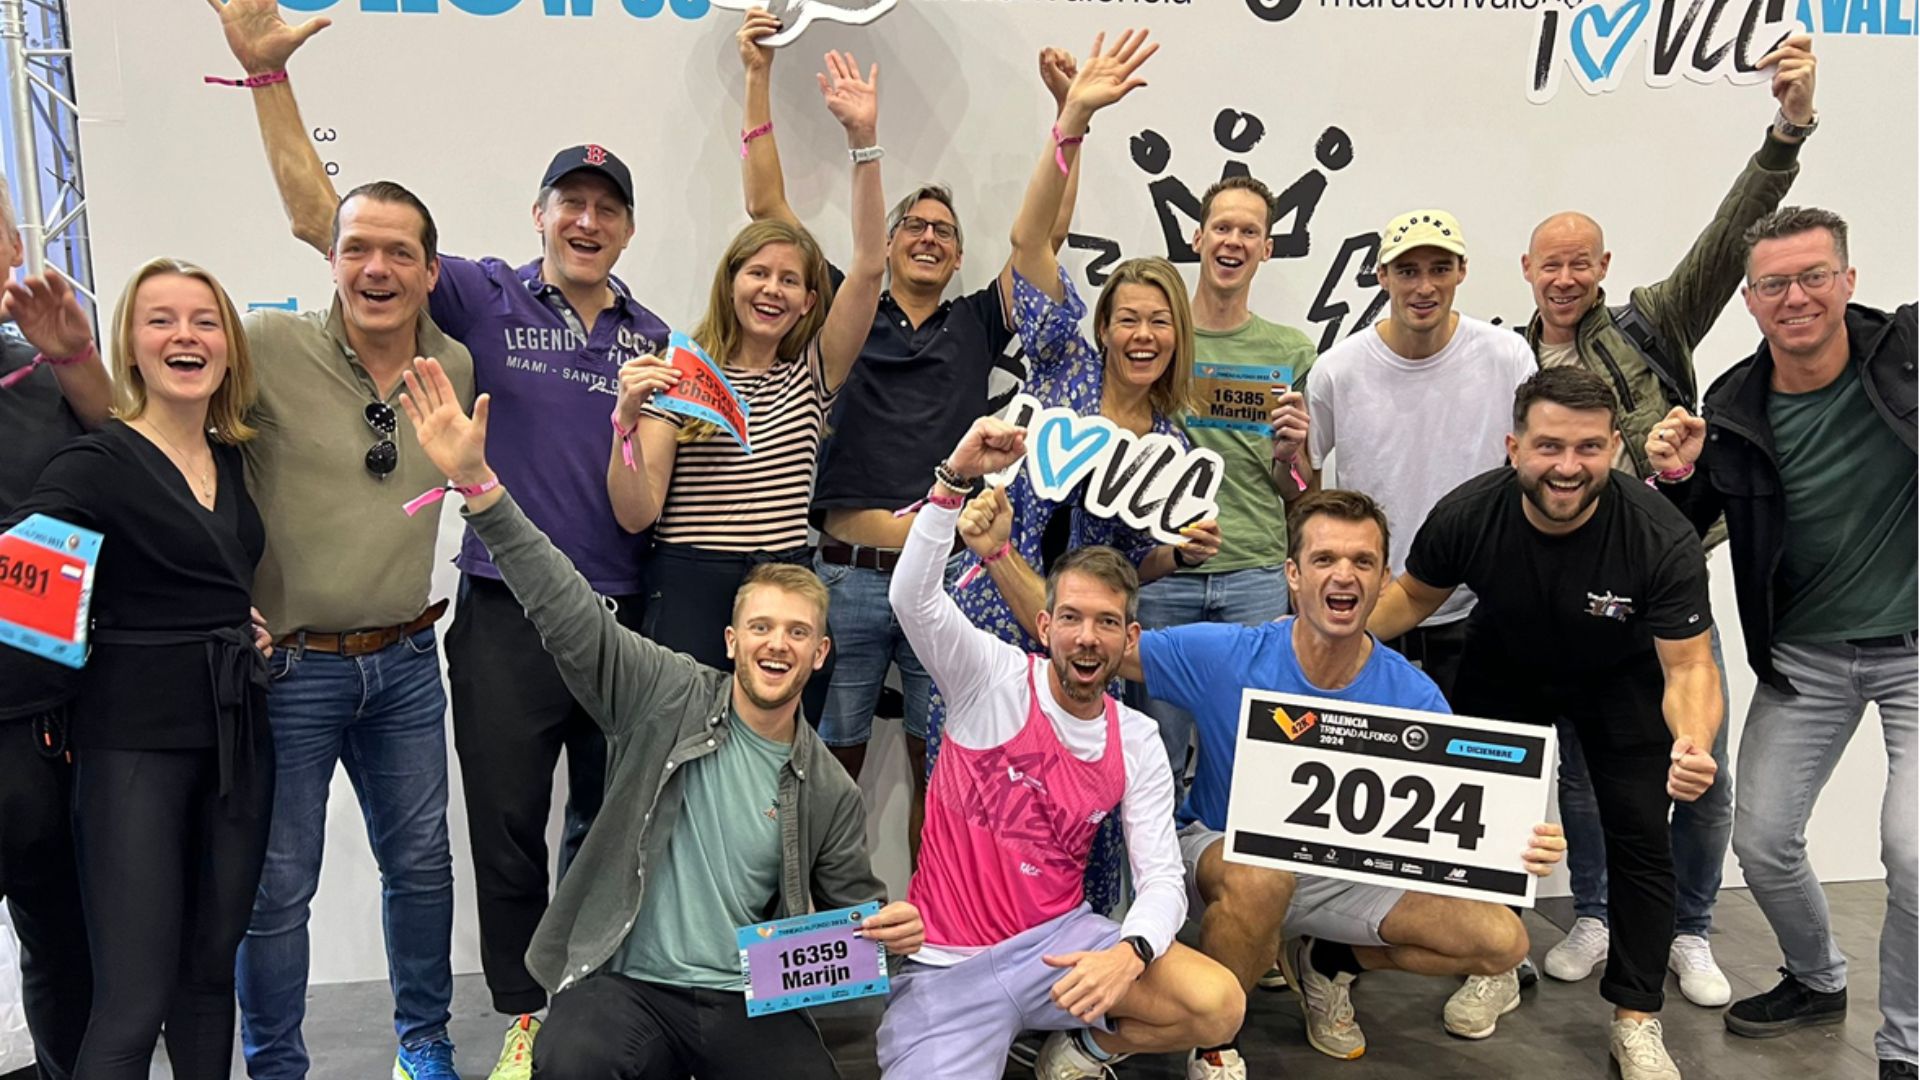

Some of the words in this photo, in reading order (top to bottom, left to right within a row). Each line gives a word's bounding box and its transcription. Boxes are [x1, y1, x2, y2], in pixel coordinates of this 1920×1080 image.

[582, 144, 607, 166] B
[1393, 215, 1451, 242] CLOSED
[505, 328, 577, 351] LEGEND
[506, 355, 547, 373] MIAMI
[1214, 388, 1264, 406] 16385
[1211, 404, 1266, 422] Martijn
[1097, 439, 1217, 534] VLC
[0, 556, 50, 595] 5491
[1320, 713, 1368, 728] VALENCIA
[1320, 725, 1357, 738] TRINIDAD
[1358, 730, 1398, 743] ALFONSO
[1320, 735, 1344, 746] 2024
[1466, 745, 1513, 759] DICIEMBRE
[1284, 761, 1486, 851] 2024
[778, 940, 848, 969] 16359
[782, 965, 850, 990] Marijn
